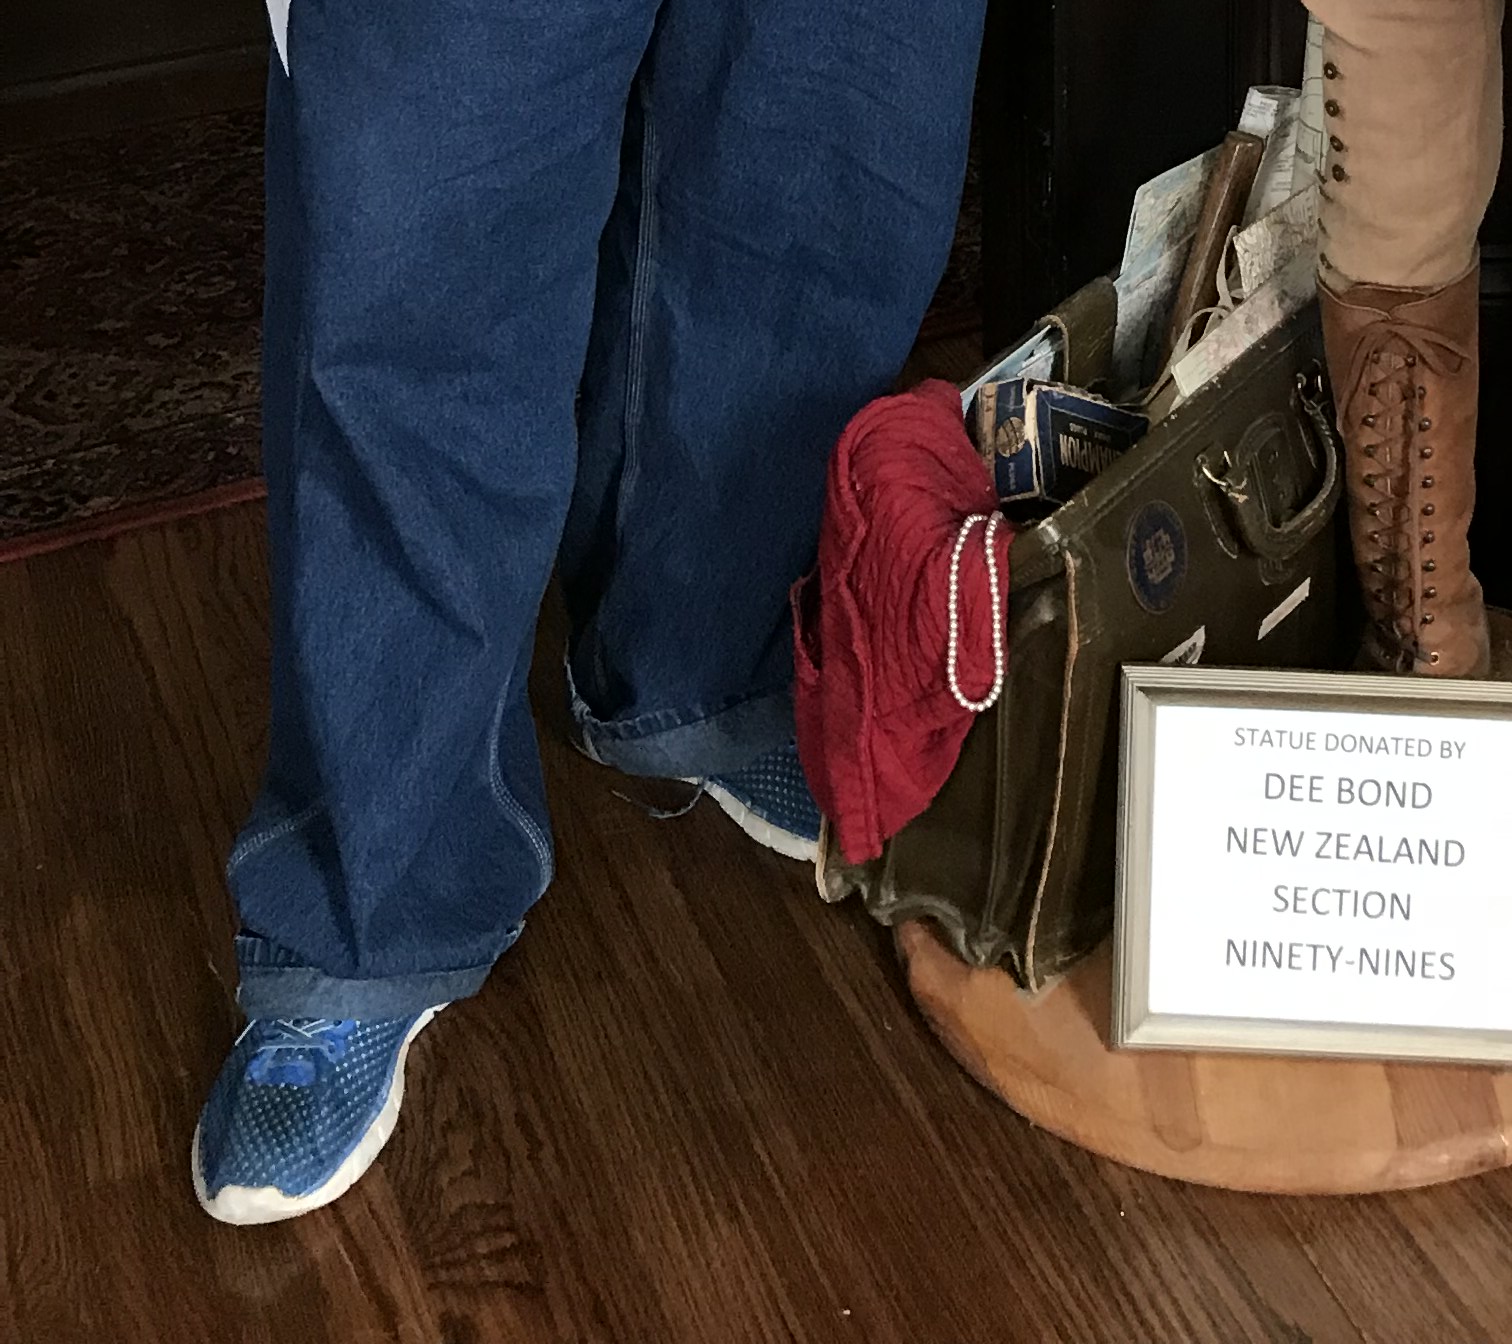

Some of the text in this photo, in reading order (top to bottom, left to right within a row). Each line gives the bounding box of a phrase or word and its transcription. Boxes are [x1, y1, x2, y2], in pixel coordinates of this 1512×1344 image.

[1059, 433, 1123, 475] HAMPION
[1235, 728, 1465, 759] STATUE DONATED BY
[1265, 773, 1432, 809] DEE BOND
[1227, 827, 1464, 867] NEW ZEALAND
[1273, 885, 1410, 920] SECTION
[1226, 939, 1455, 980] NINETY-NINES
